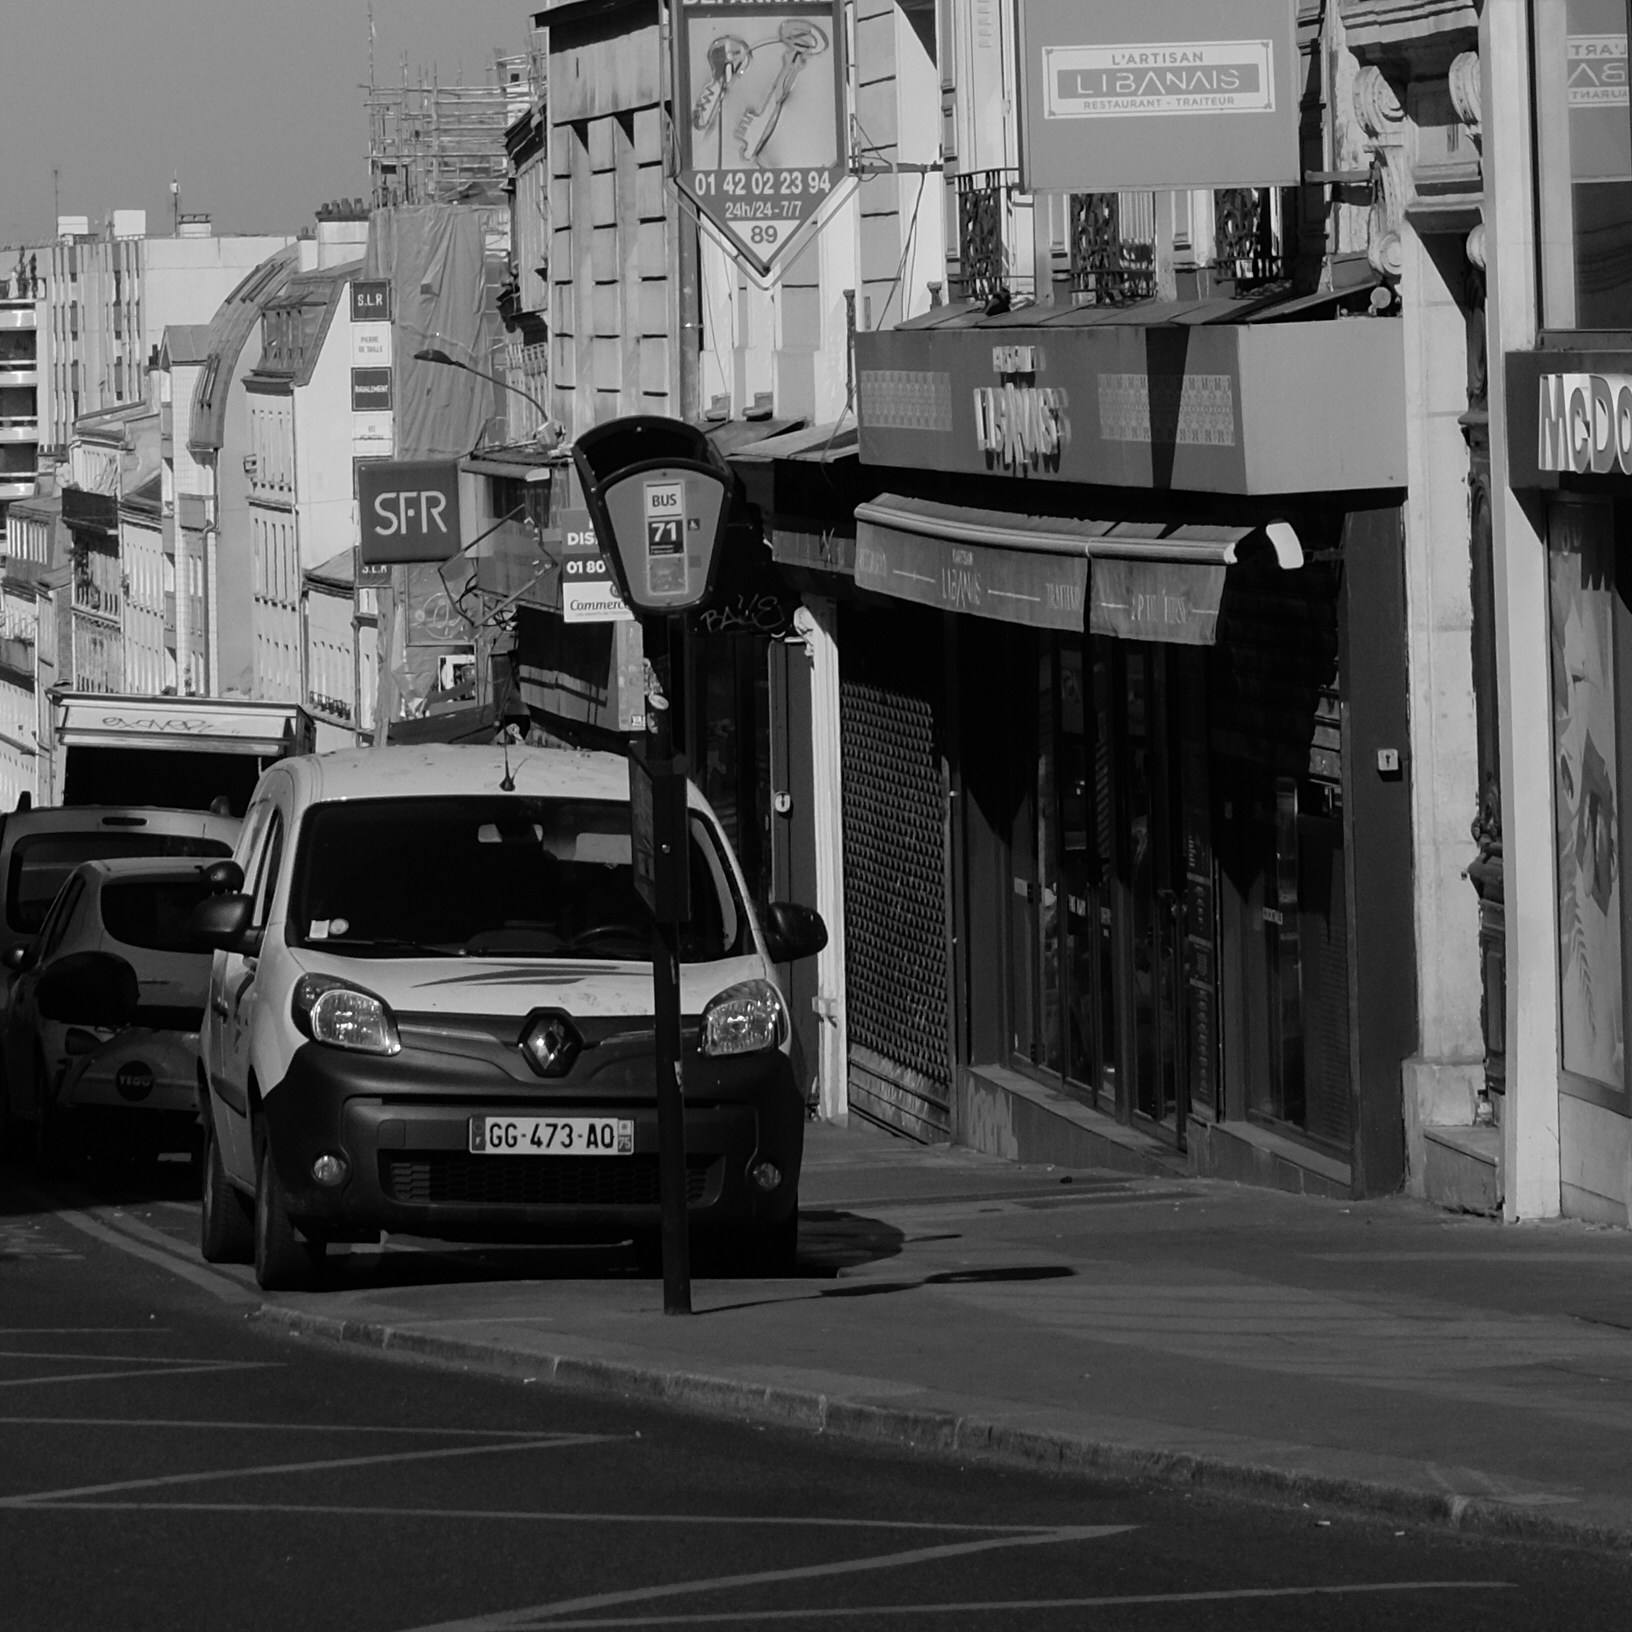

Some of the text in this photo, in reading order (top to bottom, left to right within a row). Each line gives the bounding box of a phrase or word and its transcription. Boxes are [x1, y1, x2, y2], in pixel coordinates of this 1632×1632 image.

[1112, 52, 1204, 66] L'ARTISAN
[1077, 69, 1240, 95] LIBANAIS
[1083, 98, 1162, 110] RESTAURANT
[1176, 96, 1235, 107] TRAITEUR
[695, 170, 831, 196] 01 42 02 23 94
[750, 225, 778, 244] 89
[652, 493, 677, 507] BUS
[374, 490, 447, 535] SFR
[651, 521, 677, 542] 71
[566, 560, 606, 574] 01 80
